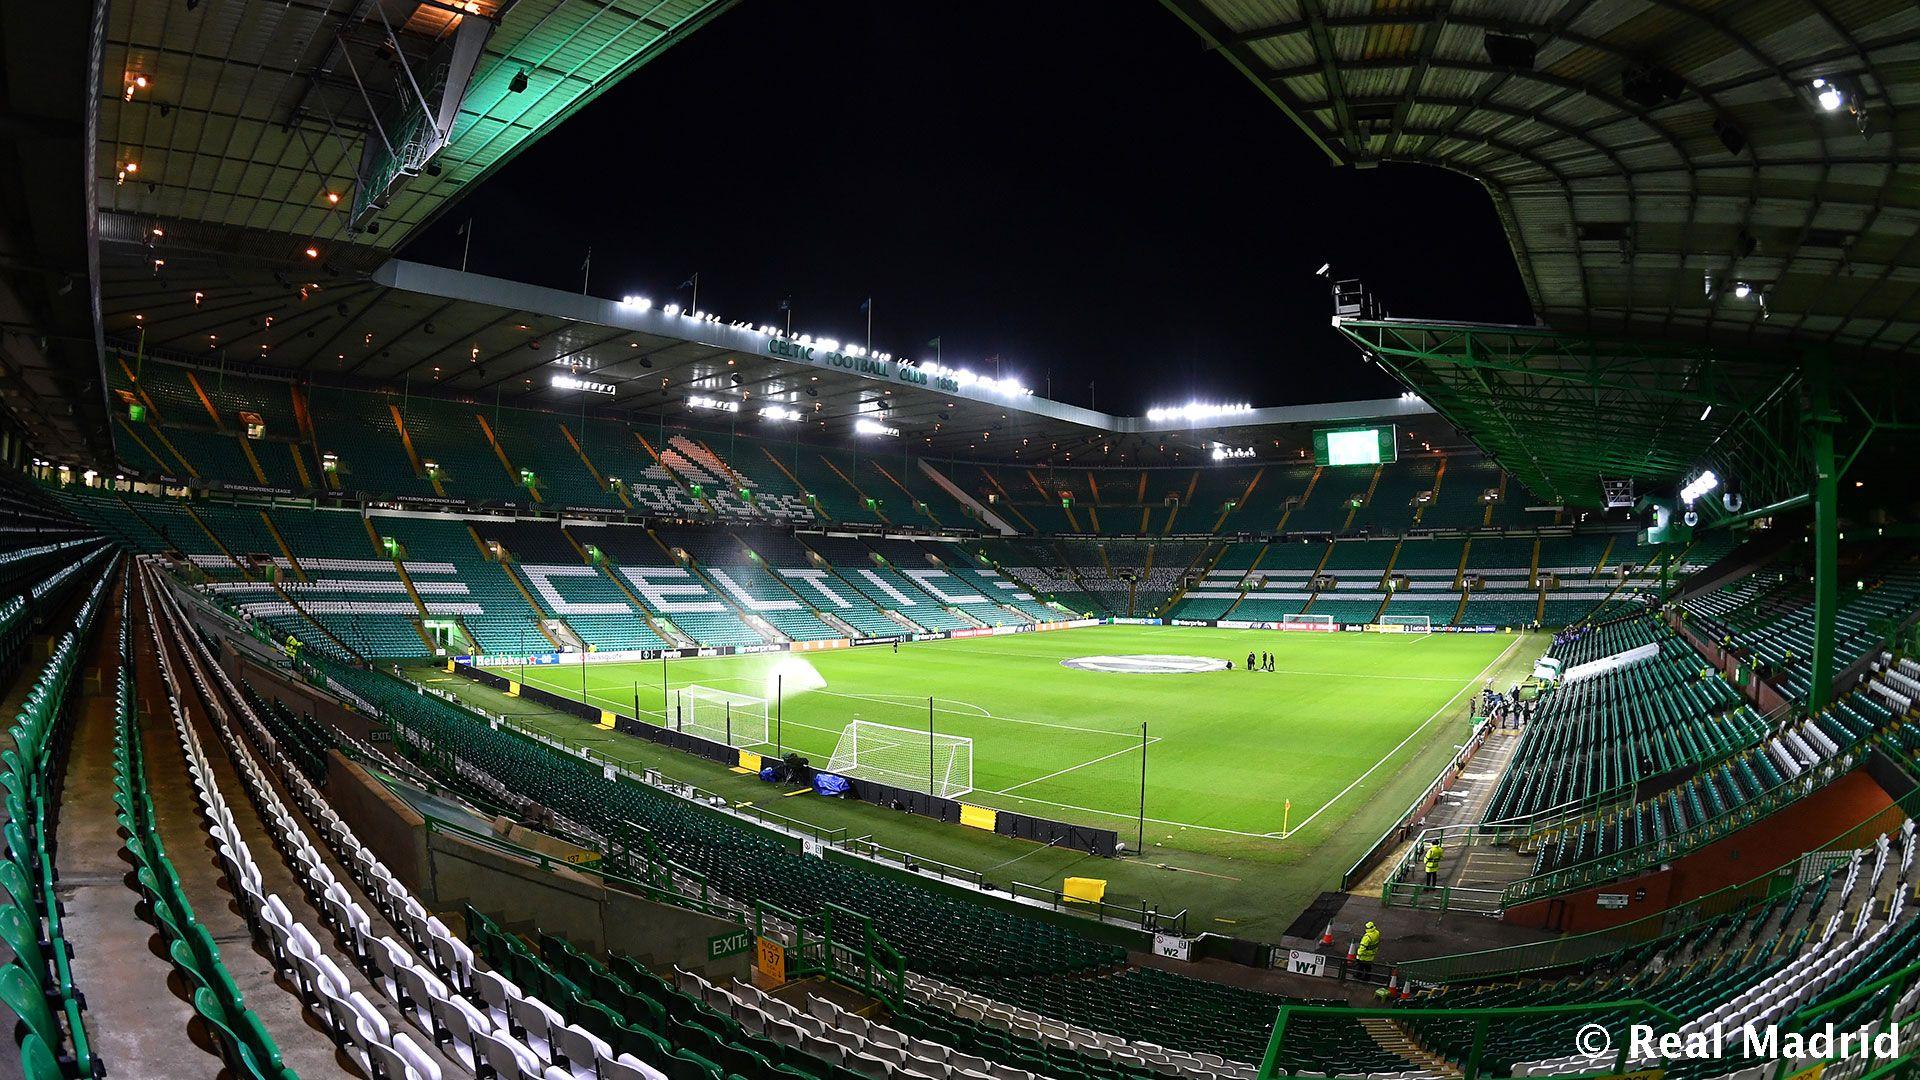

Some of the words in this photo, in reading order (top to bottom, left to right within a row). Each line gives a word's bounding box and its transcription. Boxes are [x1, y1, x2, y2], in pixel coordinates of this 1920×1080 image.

[768, 339, 815, 361] CELTIC
[826, 351, 890, 377] FOOTBALL
[899, 367, 928, 385] CLUB
[520, 564, 989, 615] CELTIC
[476, 654, 528, 666] Heineken
[371, 732, 388, 740] EXIT
[713, 934, 744, 955] EXIT
[1163, 946, 1178, 957] W2
[762, 949, 779, 965] 137
[1295, 960, 1317, 974] W1
